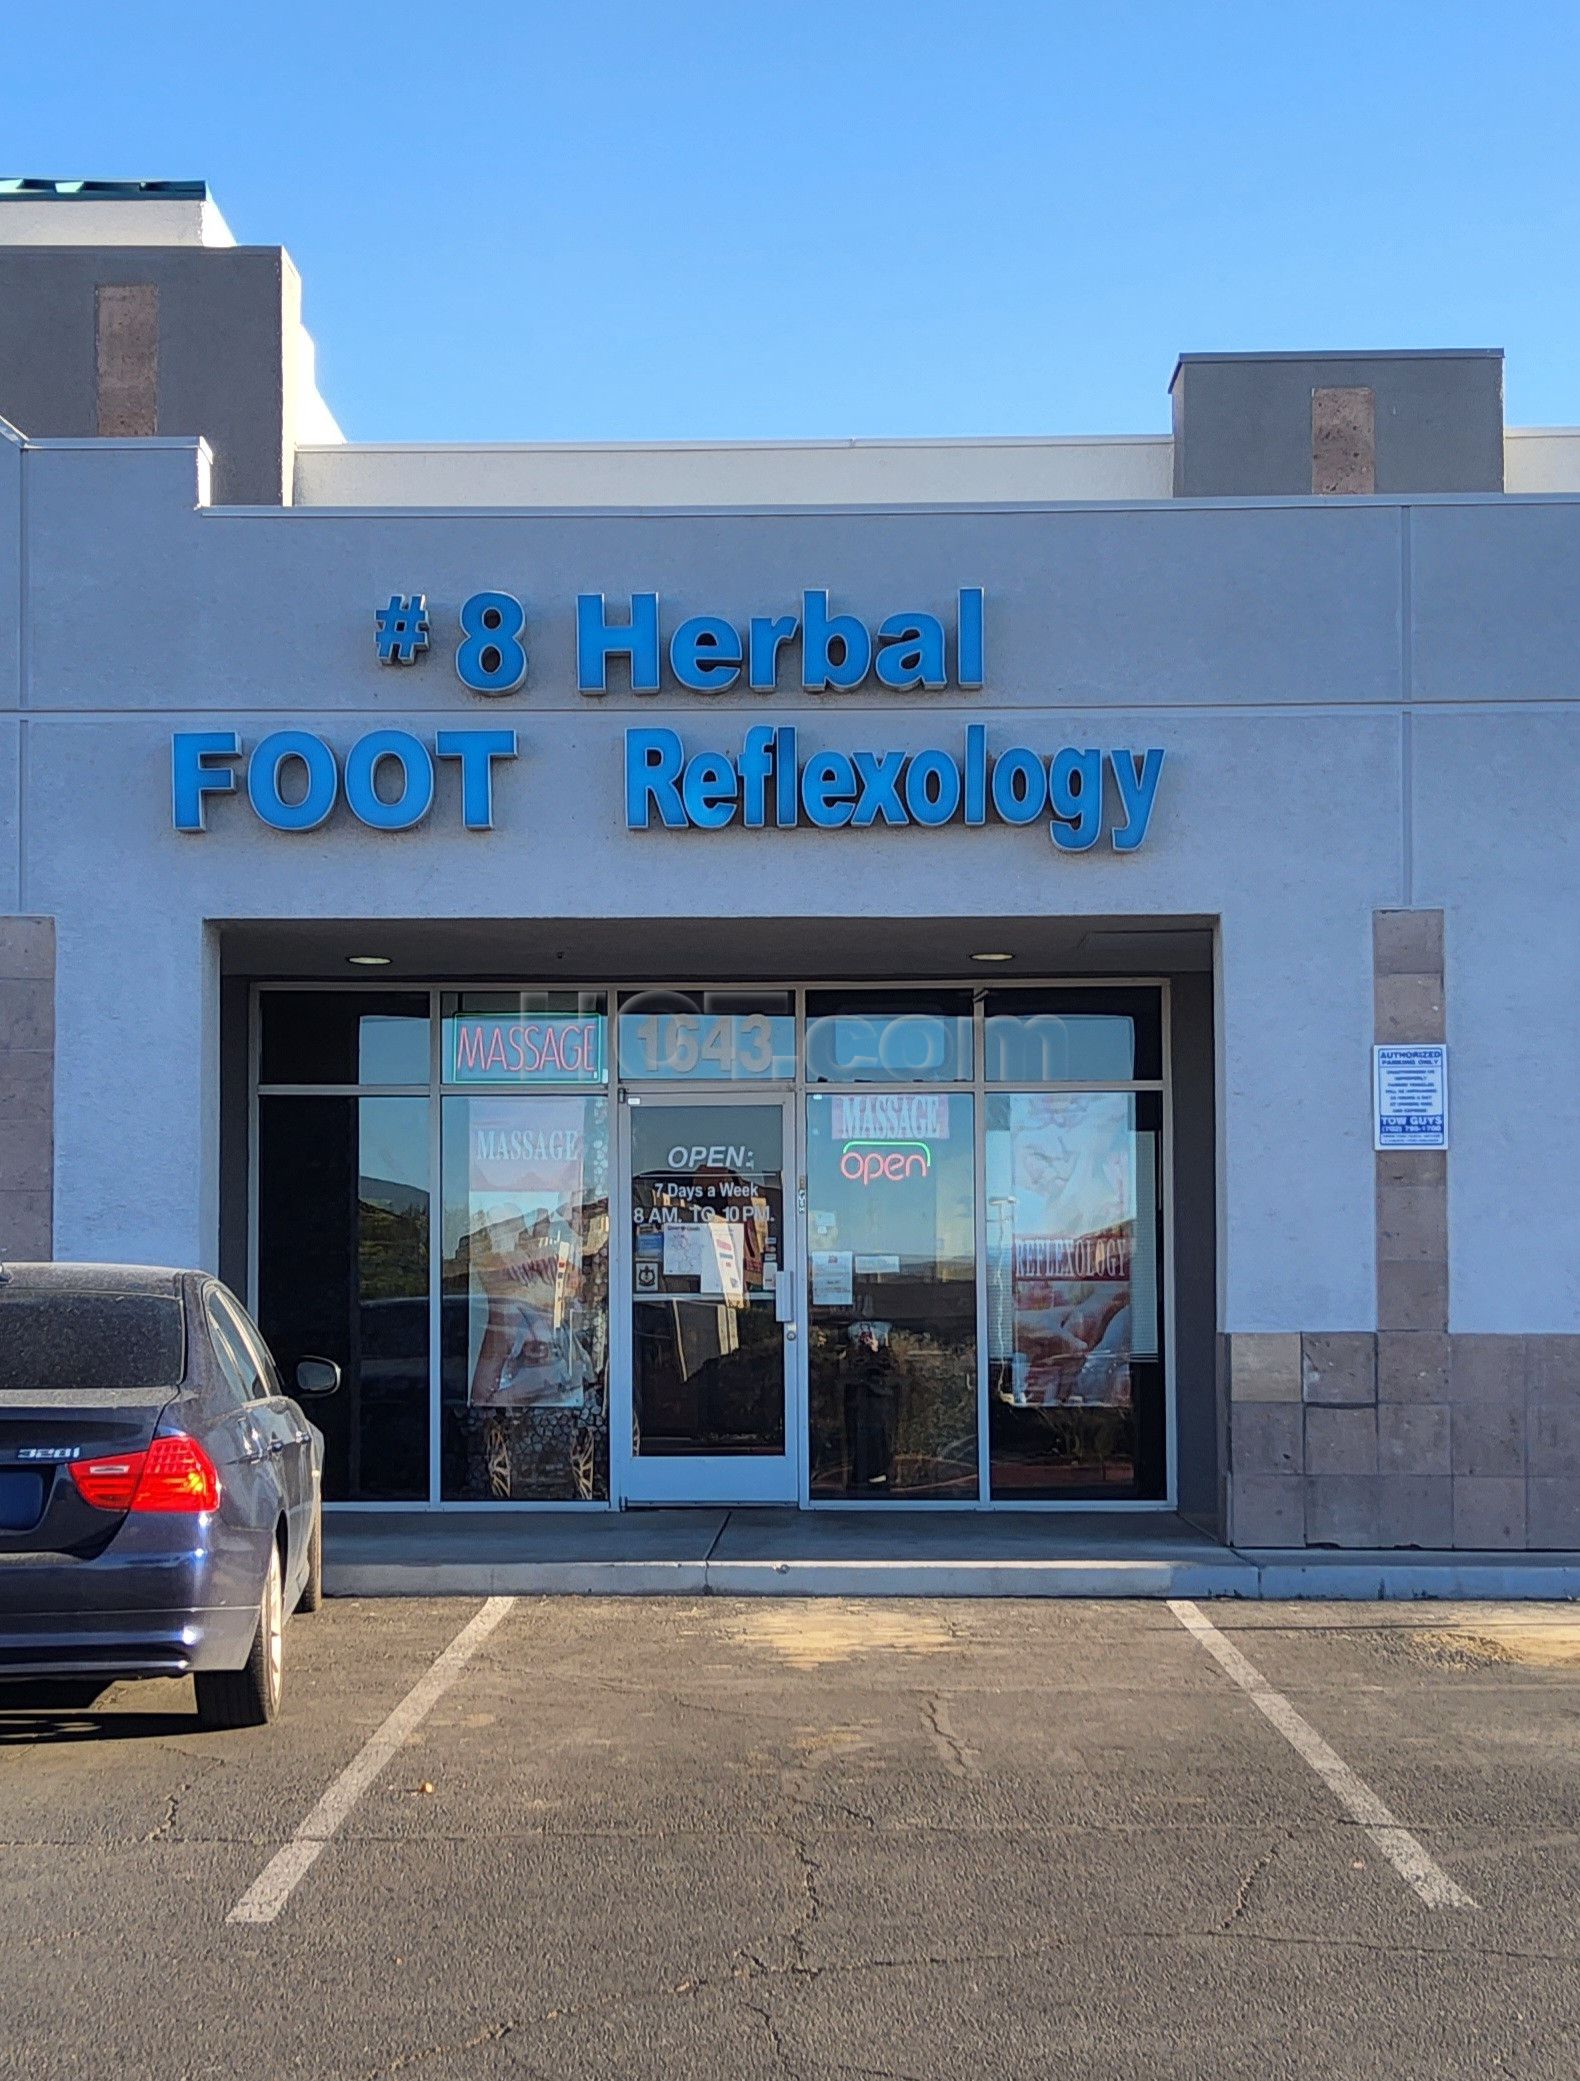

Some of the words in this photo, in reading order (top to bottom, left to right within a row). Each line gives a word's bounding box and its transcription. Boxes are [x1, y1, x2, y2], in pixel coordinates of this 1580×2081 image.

[455, 591, 528, 697] 8
[576, 586, 985, 696] Herbal
[171, 729, 518, 833] FOOT
[624, 723, 1166, 853] Reflexology
[456, 1024, 597, 1072] MASSAGE
[637, 1014, 773, 1074] 1643
[842, 1094, 941, 1140] MASSAGE
[1382, 1117, 1407, 1125] TOW
[1410, 1116, 1442, 1125] GUYS
[477, 1130, 578, 1161] MASSAGE
[654, 1183, 663, 1197] 7
[667, 1183, 703, 1200] Days
[707, 1186, 716, 1198] a
[719, 1182, 759, 1198] Week
[633, 1207, 645, 1223] 8
[722, 1206, 740, 1222] 10
[1014, 1237, 1127, 1278] REFLEXOLOGY
